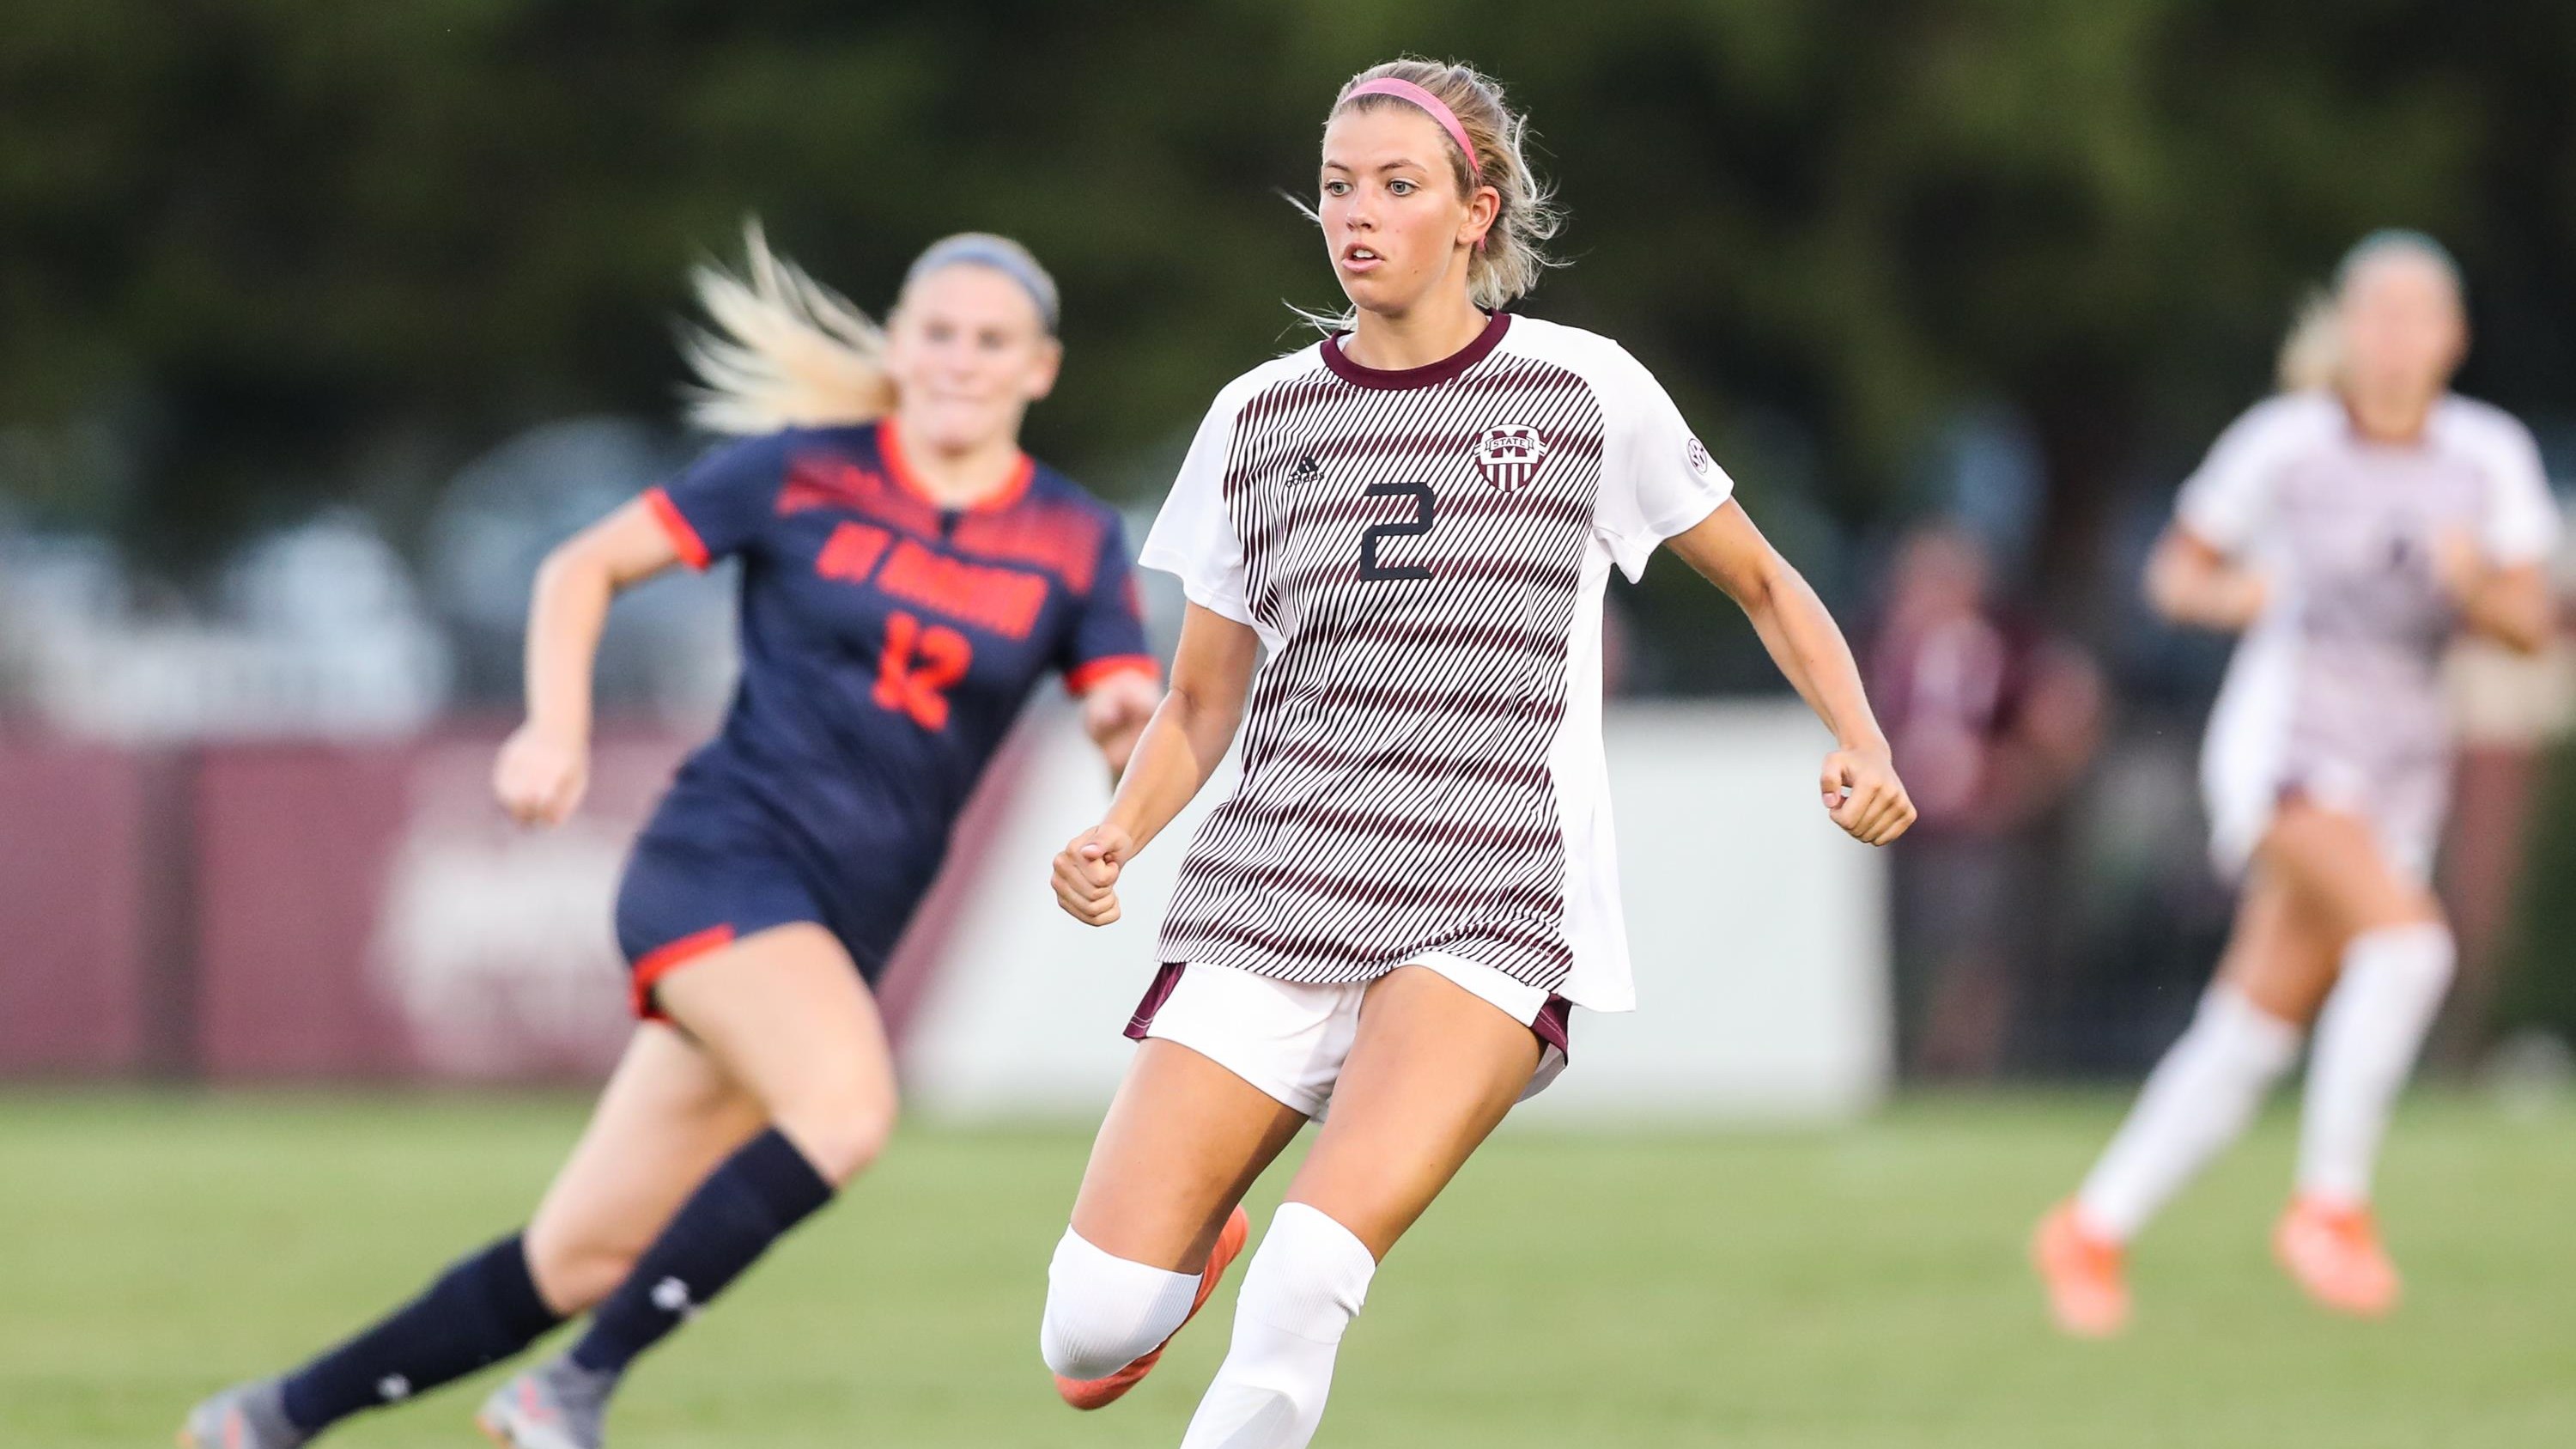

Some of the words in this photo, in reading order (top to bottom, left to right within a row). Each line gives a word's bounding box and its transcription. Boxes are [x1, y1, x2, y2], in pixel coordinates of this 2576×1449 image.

[1492, 438, 1526, 447] STATE
[1360, 482, 1434, 581] 2
[872, 611, 972, 731] 12
